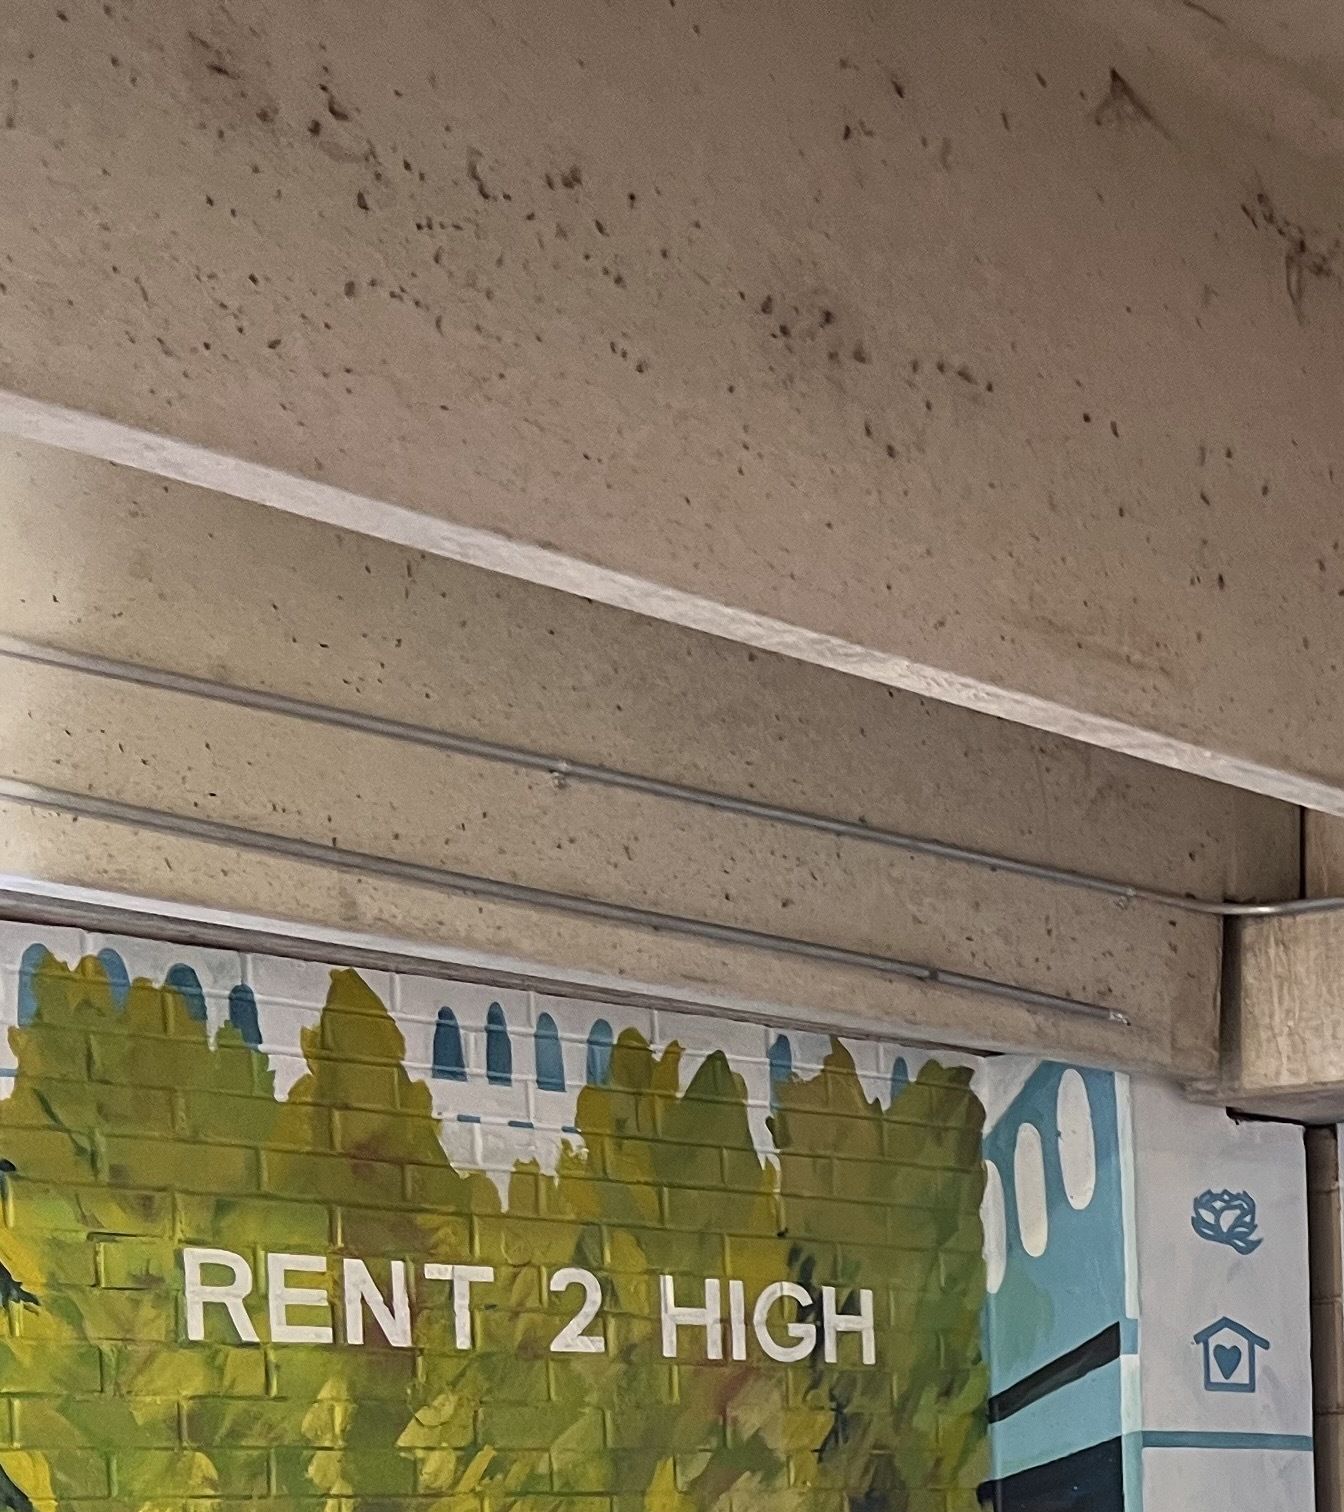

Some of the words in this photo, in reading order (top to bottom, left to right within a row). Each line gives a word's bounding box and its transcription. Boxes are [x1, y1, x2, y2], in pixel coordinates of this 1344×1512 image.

[182, 1246, 494, 1350] RENT
[548, 1267, 605, 1353] 2
[660, 1275, 876, 1365] HIGH
